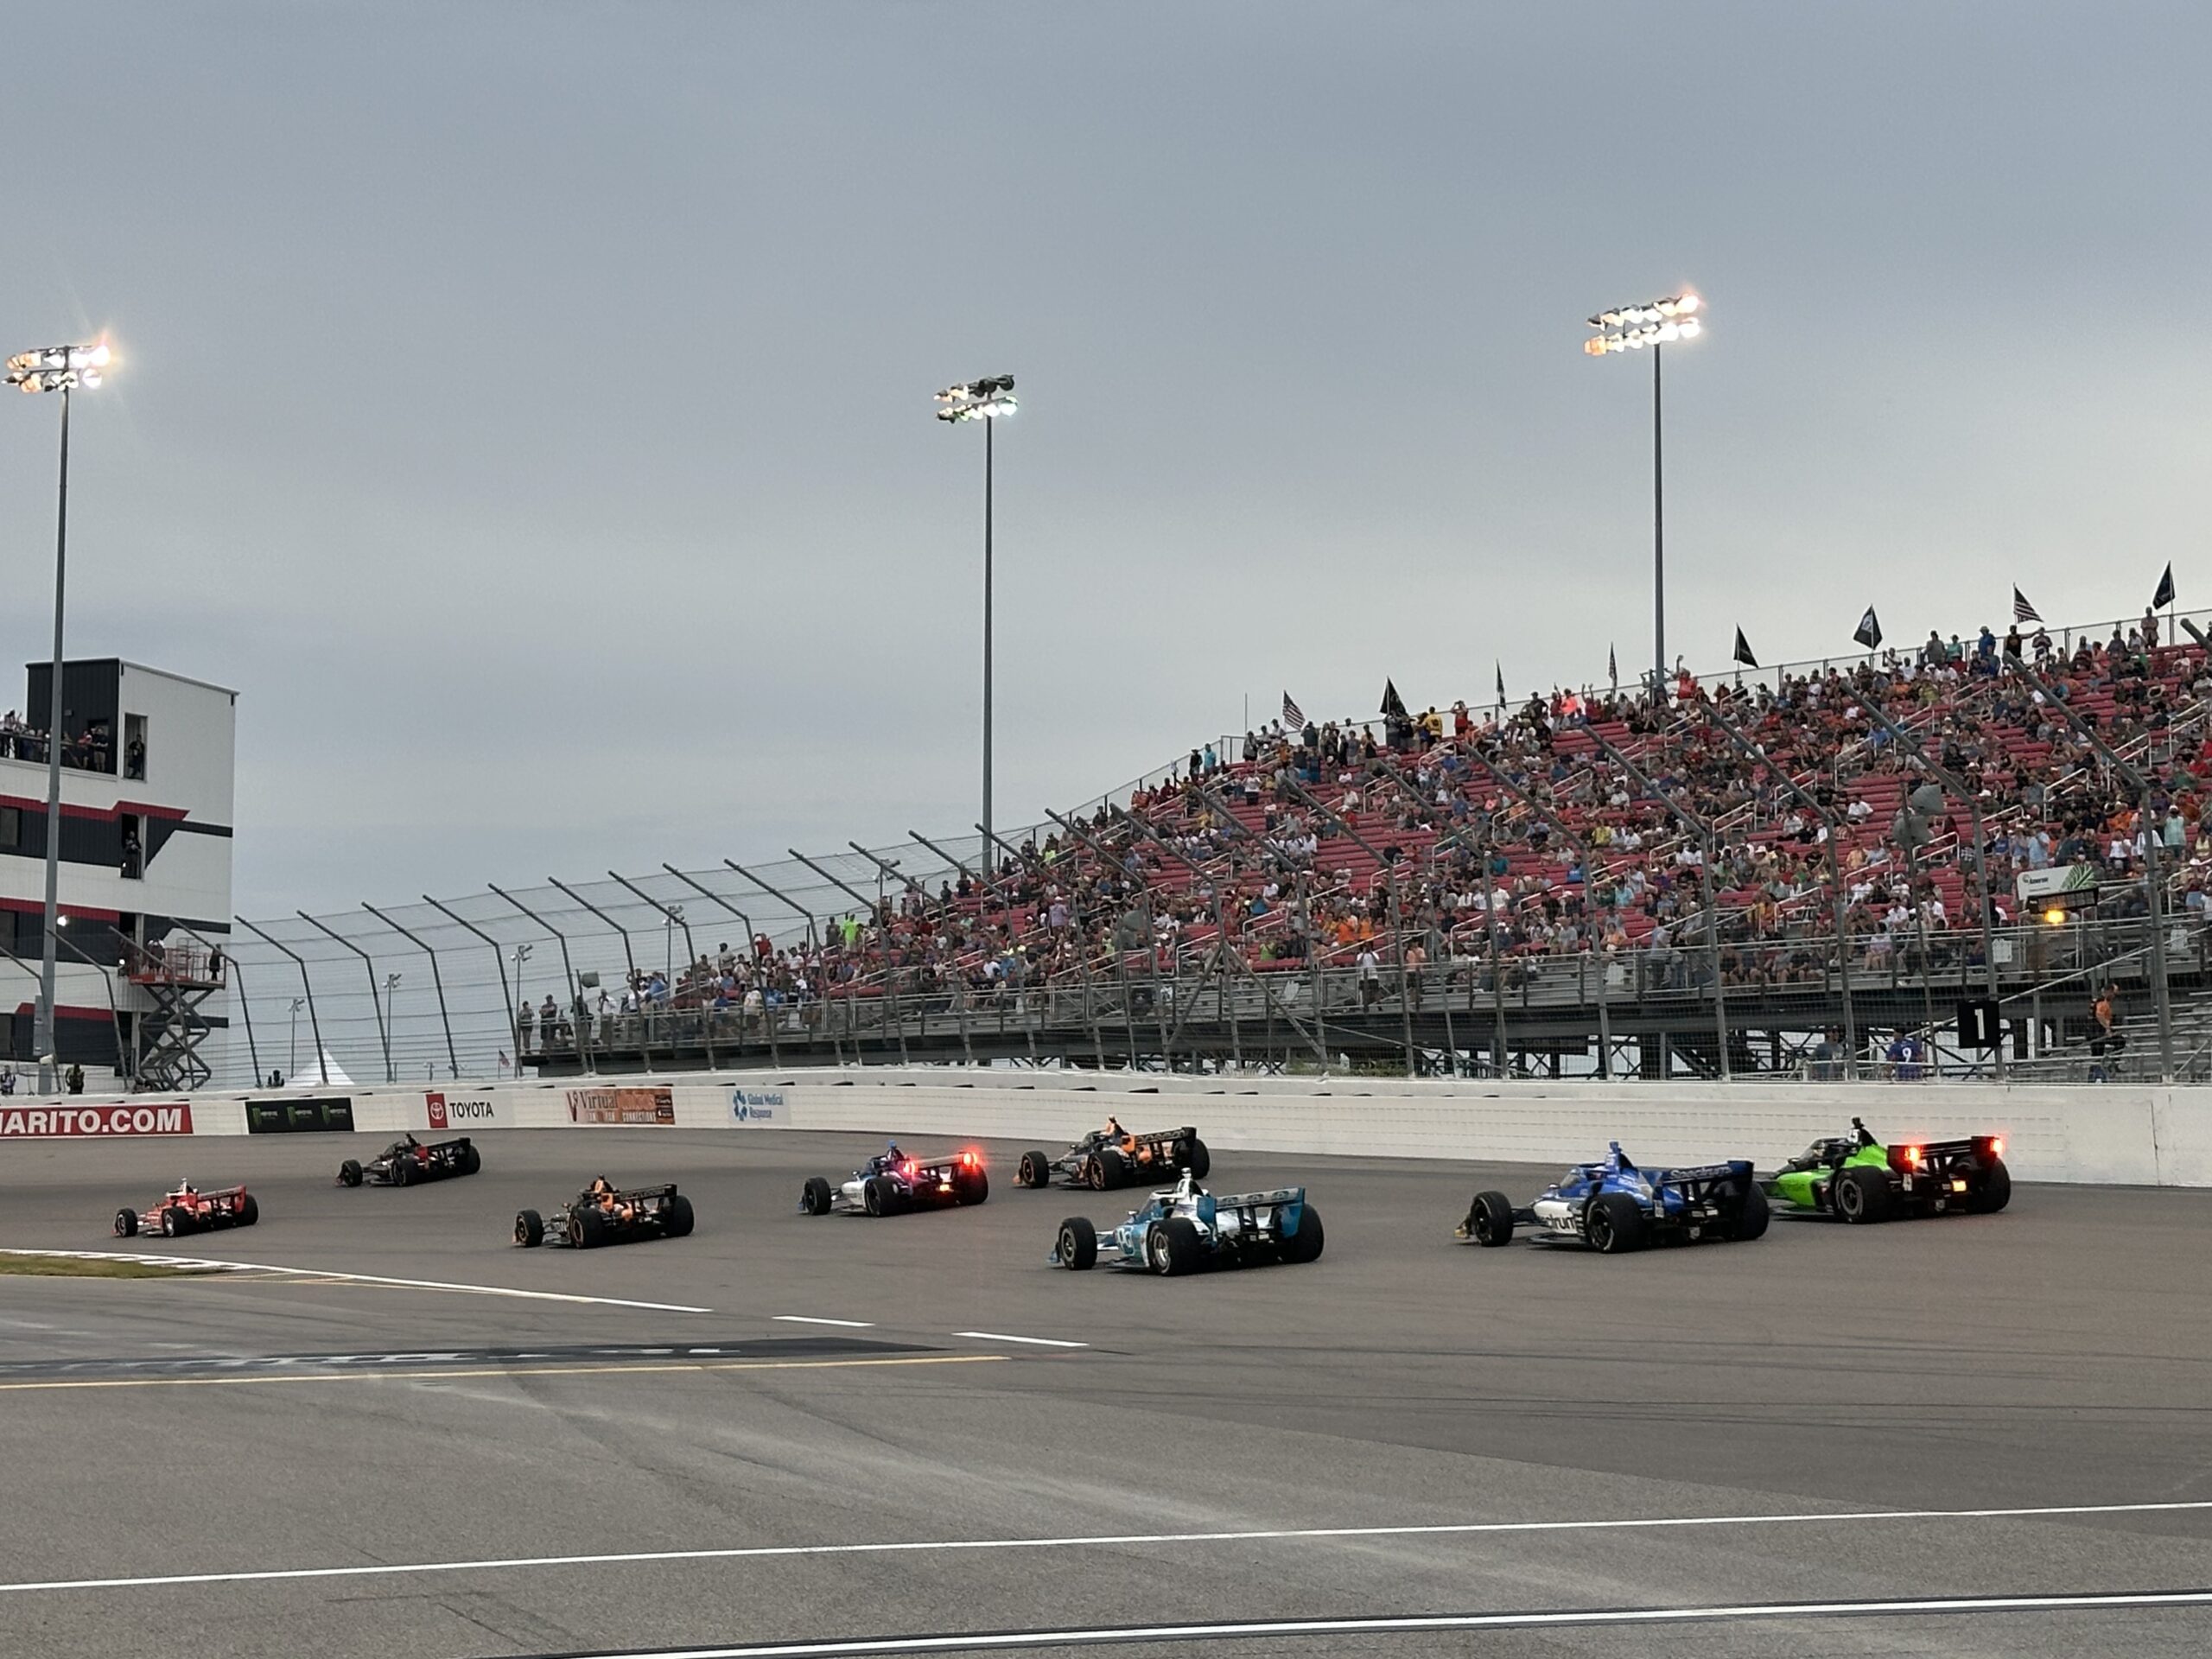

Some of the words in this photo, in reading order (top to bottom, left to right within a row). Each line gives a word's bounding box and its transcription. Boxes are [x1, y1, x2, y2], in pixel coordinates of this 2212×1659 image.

[1974, 1008, 1985, 1039] 1
[1902, 1047, 1912, 1063] 9
[580, 1090, 619, 1109] Virtual
[449, 1102, 494, 1118] TOYOTA
[0, 1108, 182, 1135] ARITO.COM
